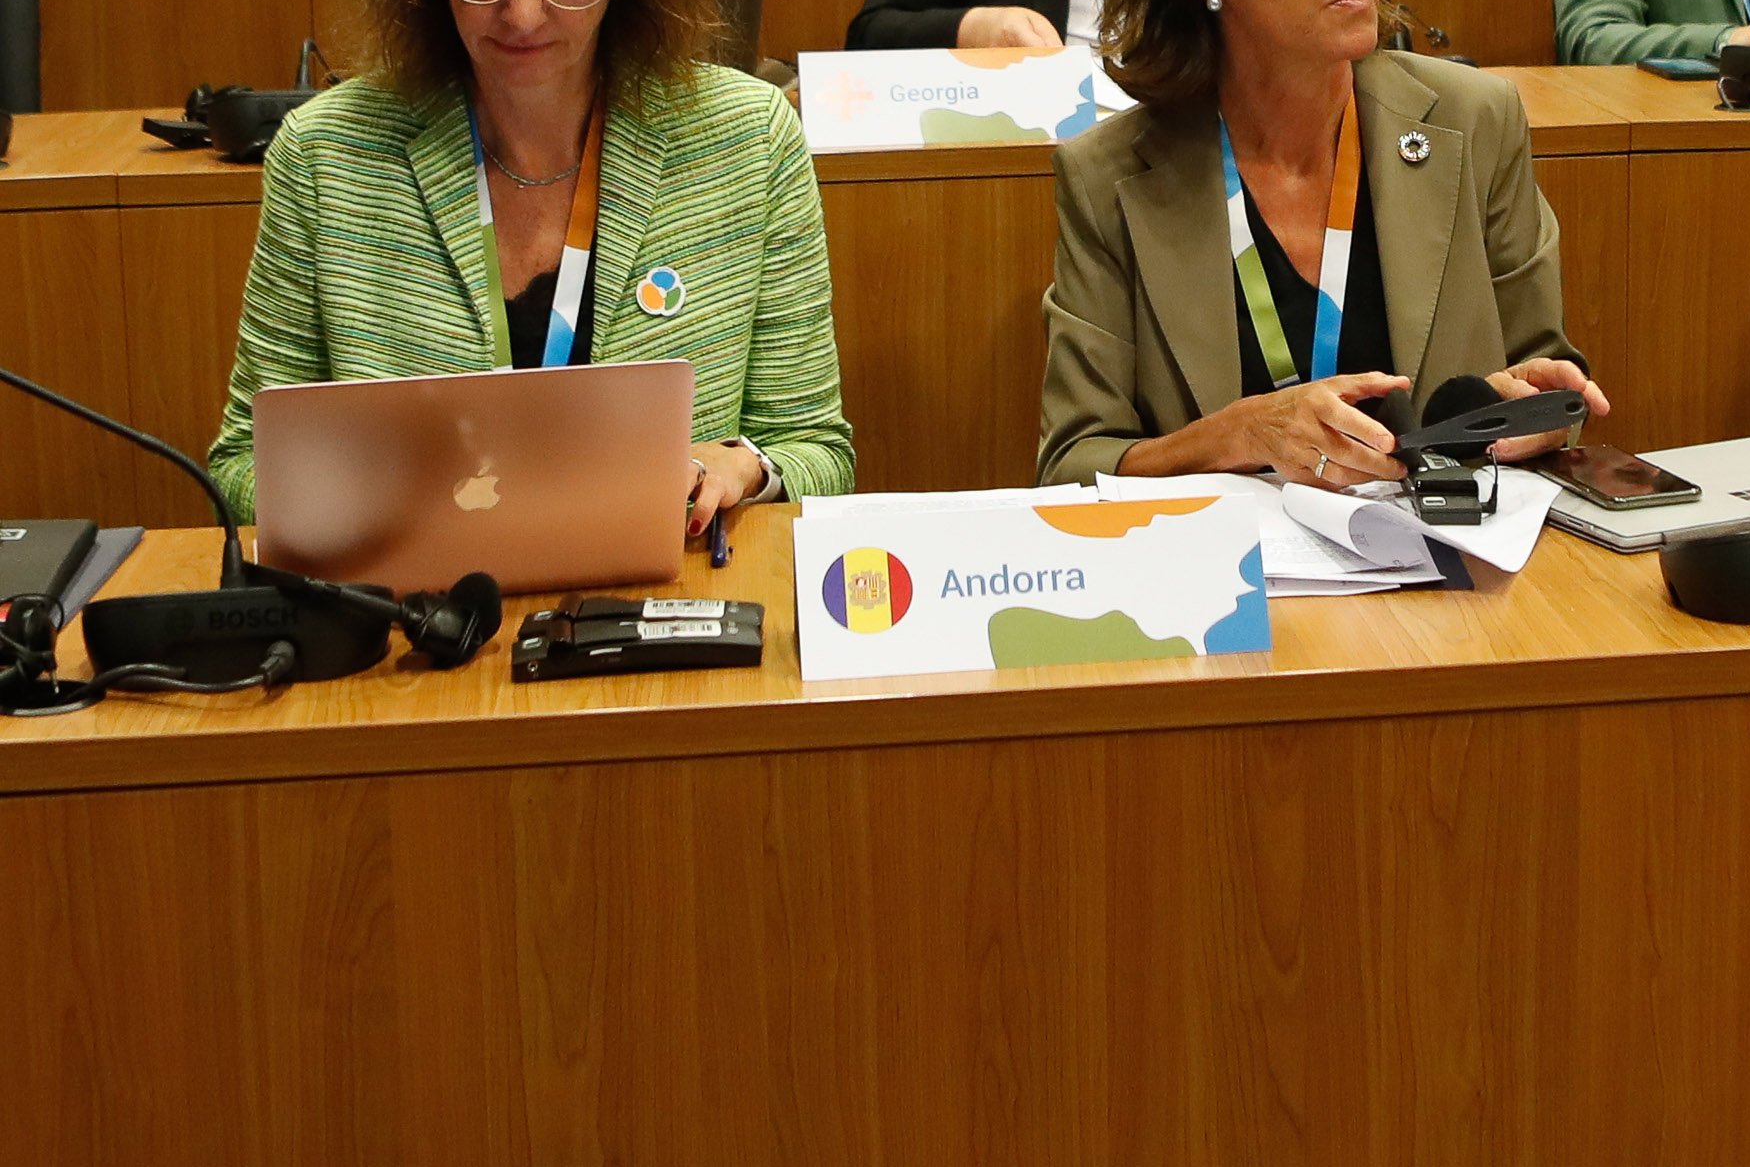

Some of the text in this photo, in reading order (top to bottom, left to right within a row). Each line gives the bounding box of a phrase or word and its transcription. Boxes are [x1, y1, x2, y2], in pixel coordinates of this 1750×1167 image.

[889, 81, 979, 104] Georgia
[940, 563, 1086, 599] Andorra
[208, 605, 299, 631] BOSCH
